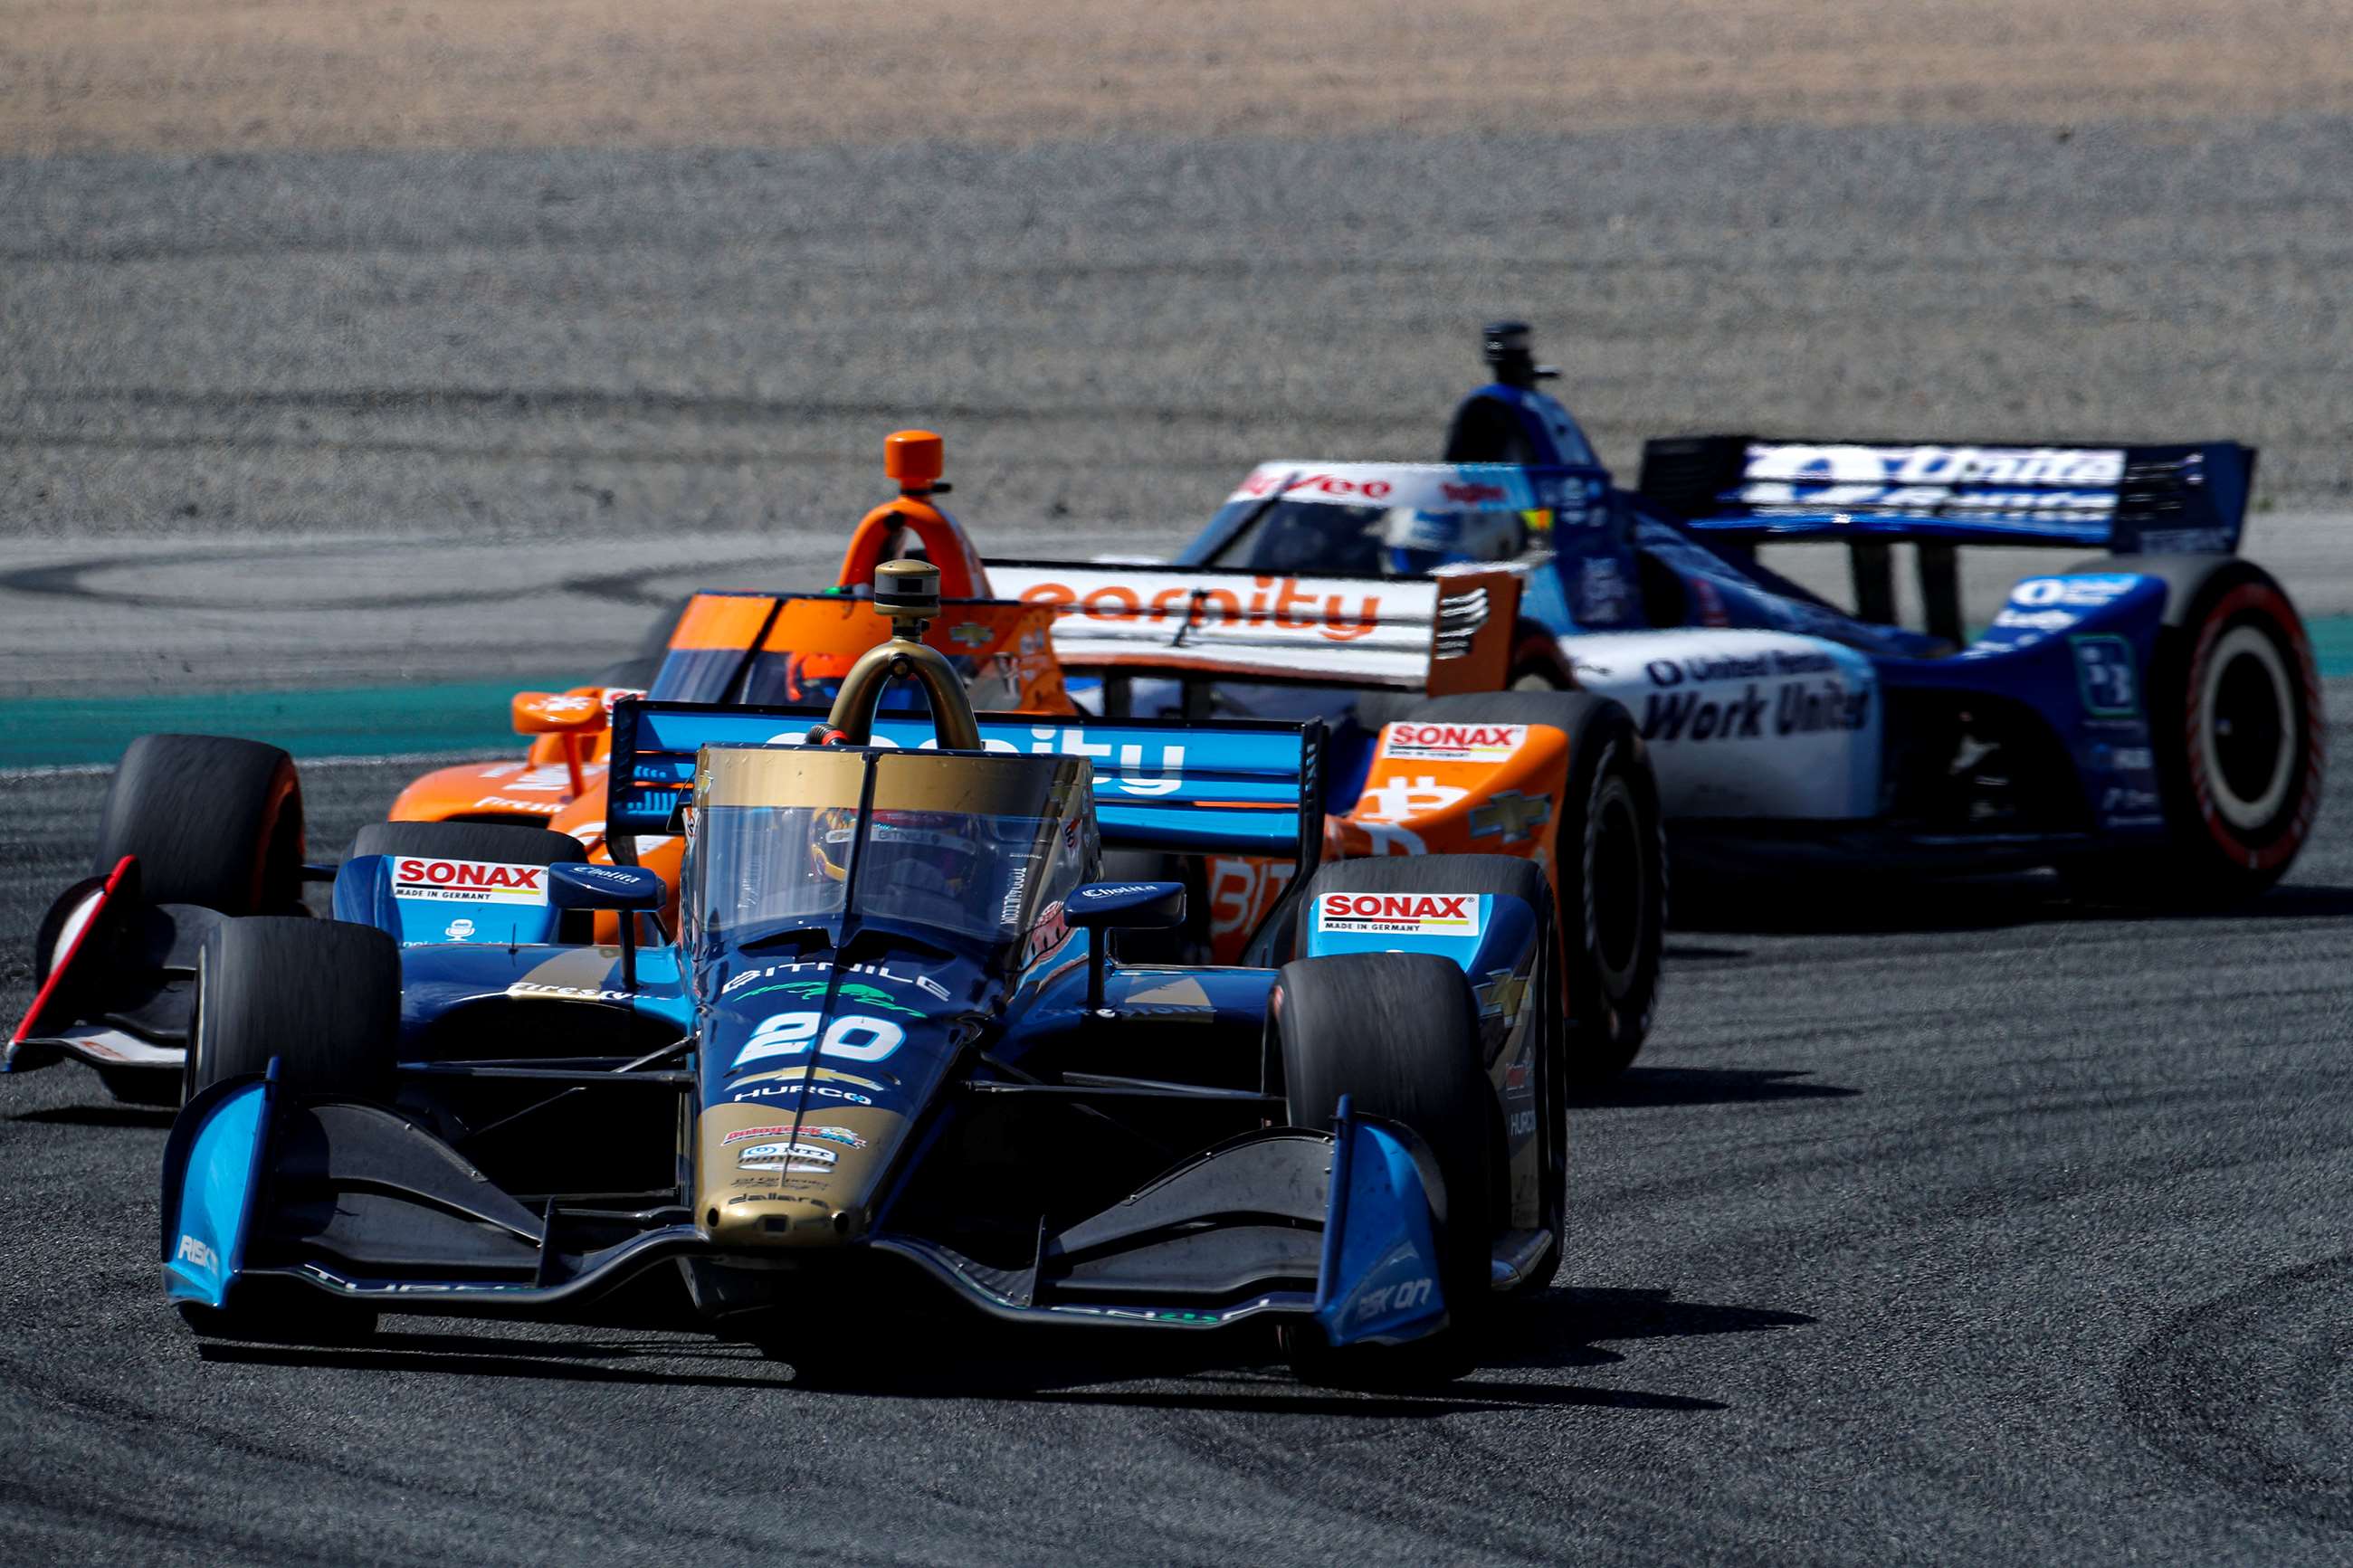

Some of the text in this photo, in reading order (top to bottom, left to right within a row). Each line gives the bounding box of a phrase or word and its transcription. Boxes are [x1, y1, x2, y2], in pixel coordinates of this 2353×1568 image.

[1020, 575, 1380, 641] earnity
[1641, 685, 1767, 743] Work
[1393, 725, 1514, 746] SONAX
[398, 860, 541, 889] SONAX
[395, 889, 491, 901] MADE IN GERMANY
[1325, 895, 1468, 918] SONAX
[1325, 922, 1420, 932] MADE IN GERMANY
[721, 962, 951, 1003] BITNILE
[730, 1011, 906, 1069] 20
[734, 1085, 872, 1106] HURCO
[729, 1193, 830, 1210] dallara
